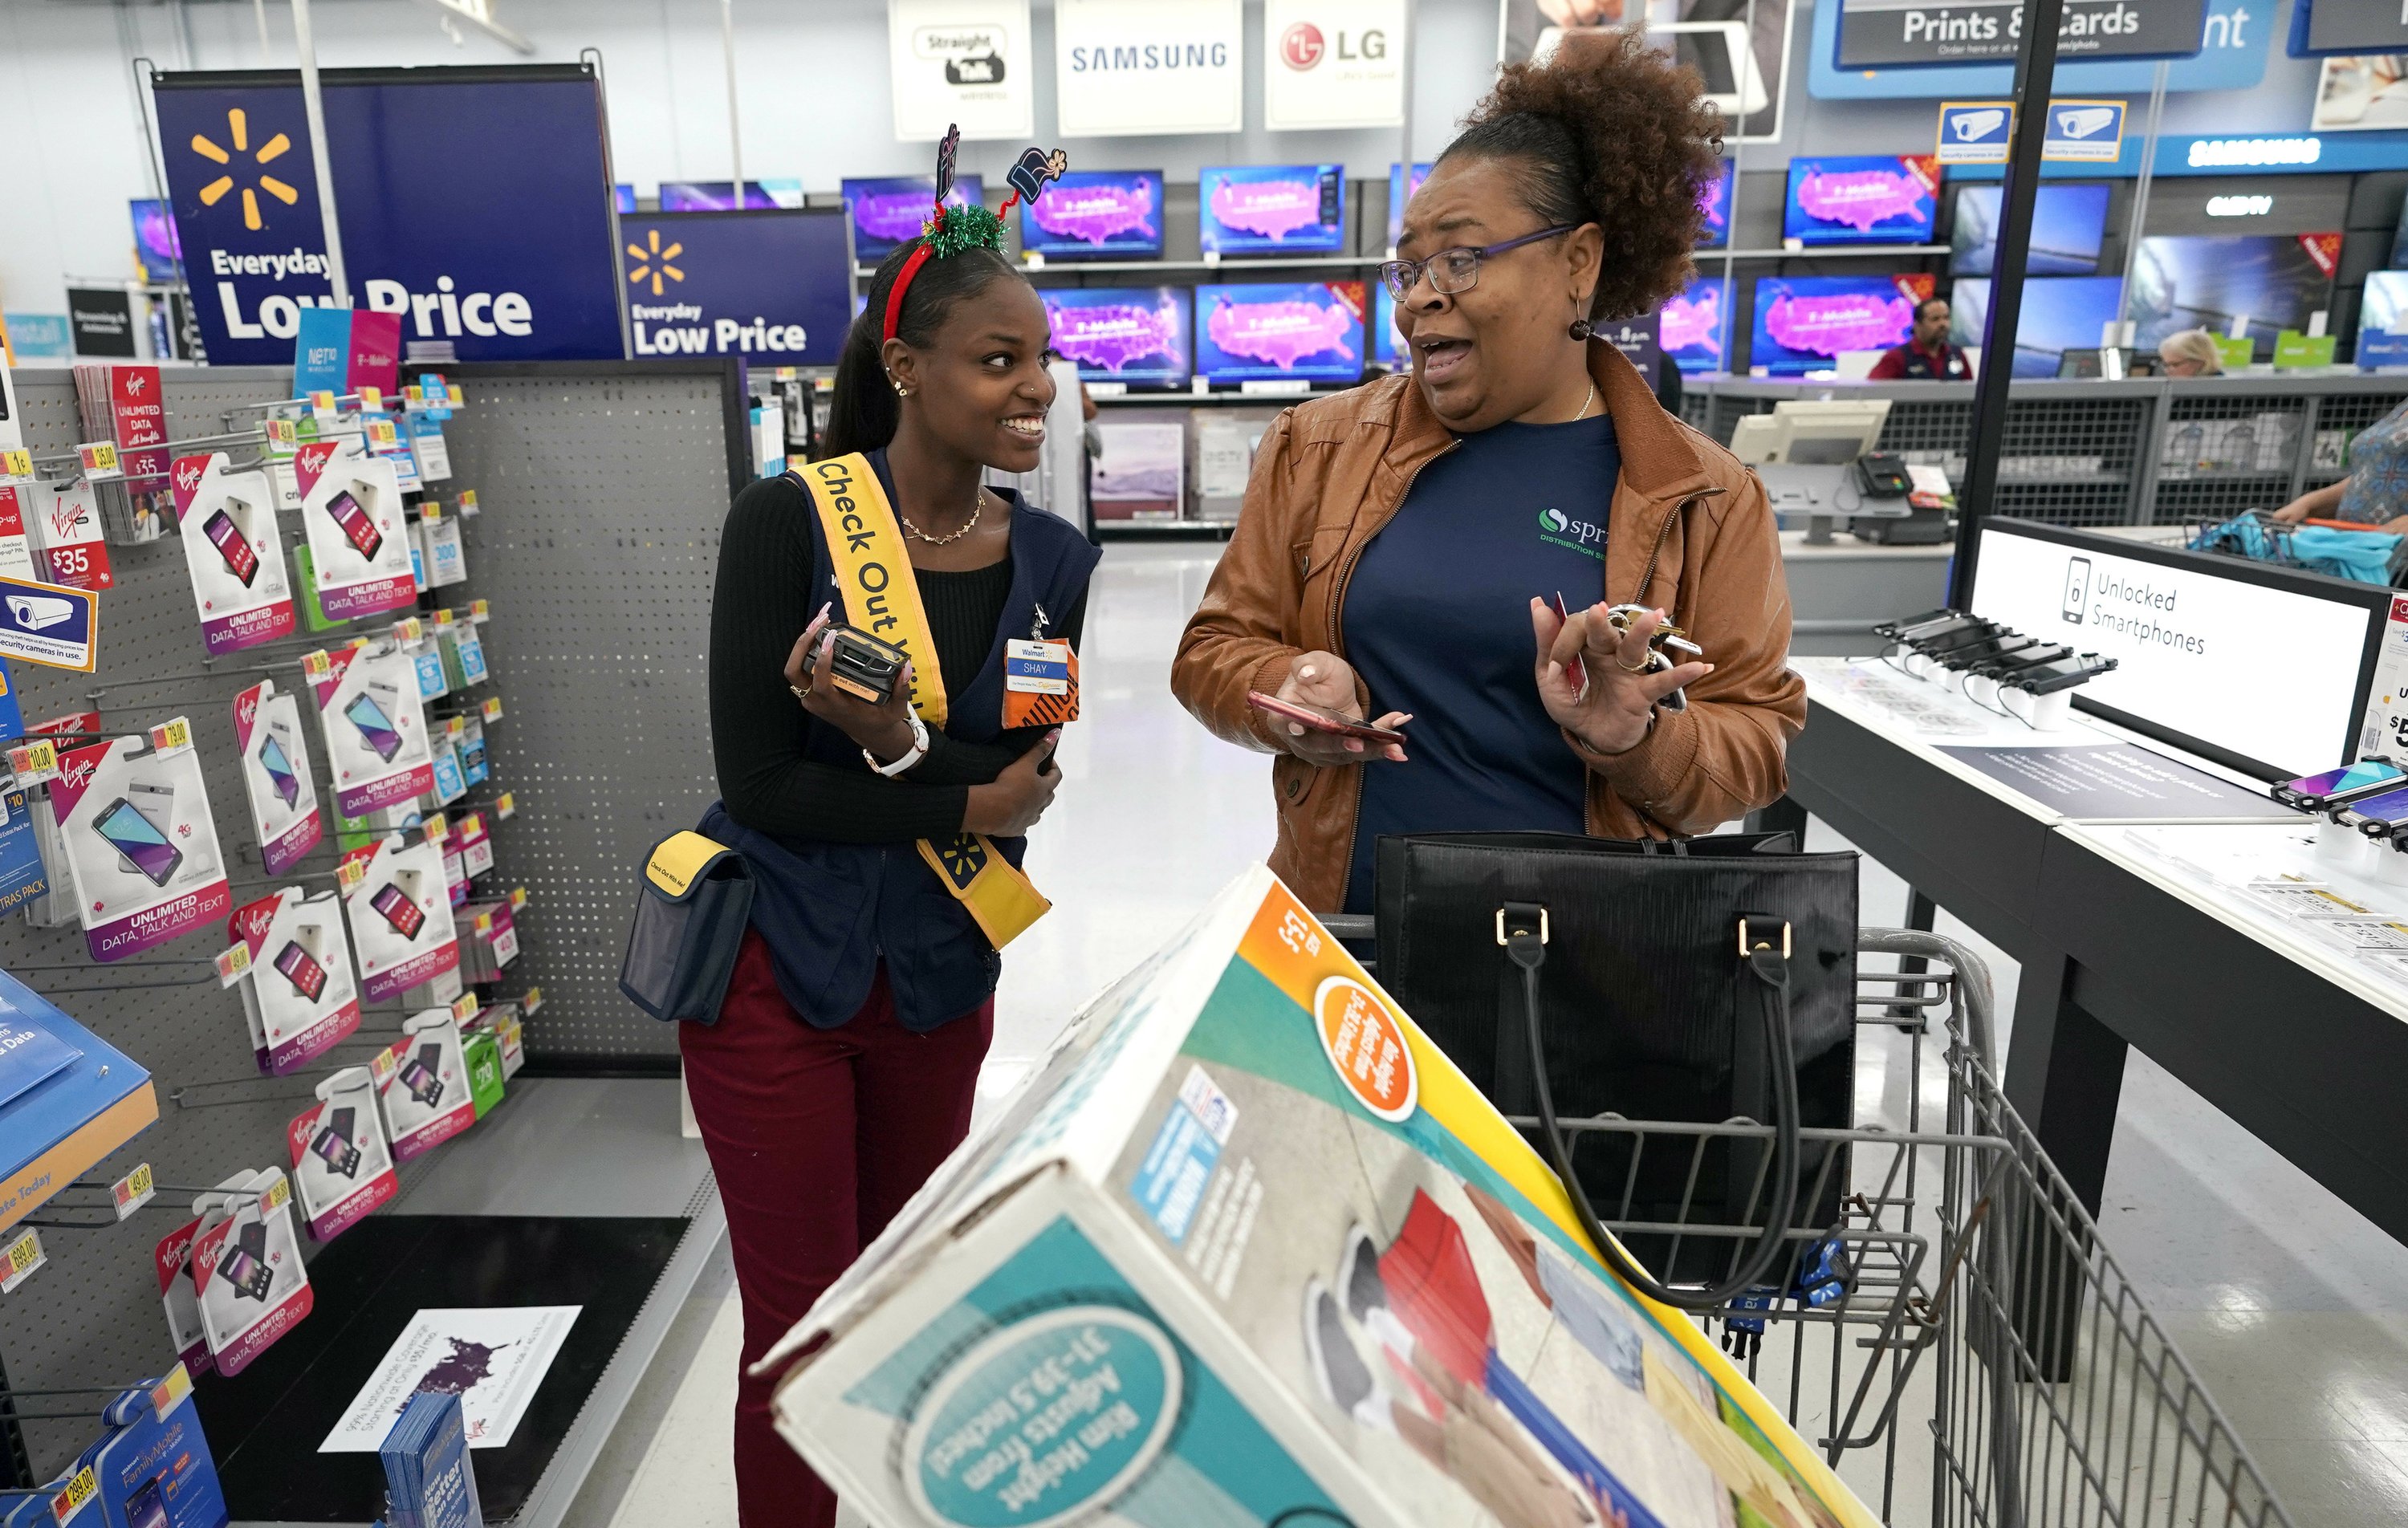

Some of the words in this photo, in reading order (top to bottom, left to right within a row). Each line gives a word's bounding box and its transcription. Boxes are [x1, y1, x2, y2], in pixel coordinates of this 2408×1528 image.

[1903, 10, 1999, 42] Prints
[928, 35, 992, 50] Straight
[1337, 30, 1386, 60] LG
[1072, 43, 1227, 73] SAMSUNG
[210, 250, 334, 281] Everyday
[365, 276, 533, 337] Price
[631, 303, 702, 322] Everyday
[633, 321, 710, 355] Low
[714, 316, 807, 352] Price
[119, 404, 160, 417] UNLIMITED
[131, 420, 152, 430] DATA
[177, 462, 200, 491] Virgin
[52, 497, 85, 538] Virgin
[817, 462, 877, 554] Check
[858, 562, 897, 633] Out
[1540, 534, 1594, 556] DISTRIBUTION
[53, 548, 89, 575] $35
[348, 580, 395, 597] UNLIMITED
[355, 595, 375, 605] TALK
[376, 591, 393, 601] AND
[394, 585, 413, 597] TEXT
[2097, 572, 2178, 613] Unlocked
[211, 631, 235, 644] DATA,
[236, 624, 254, 639] TALK
[254, 620, 271, 633] AND
[272, 612, 290, 627] TEXT
[230, 608, 272, 628] UNLIMITED
[2092, 605, 2206, 656] Smartphones
[0, 639, 25, 651] ecurity
[26, 644, 55, 656] cameras
[56, 649, 64, 657] in
[65, 652, 82, 660] use.
[1022, 648, 1045, 657] Walmart
[839, 676, 848, 685] out
[848, 681, 860, 690] with
[1023, 663, 1047, 673] SHAY
[59, 758, 93, 789] Virgin
[366, 772, 413, 794] UNLIMITED
[373, 790, 392, 801] TALK
[393, 781, 411, 793] AND
[412, 773, 430, 786] TEXT
[7, 793, 23, 807] $10
[178, 823, 191, 835] 4G
[283, 819, 310, 846] UNLIMITED
[299, 835, 310, 848] AND
[22, 879, 47, 898] PACK
[651, 861, 662, 873] Check
[661, 868, 669, 878] Out
[669, 873, 677, 884] With
[677, 880, 685, 888] Me!
[103, 933, 139, 951] DATA,
[140, 917, 169, 936] TALK
[172, 906, 196, 925] AND
[198, 894, 225, 912] TEXT
[131, 895, 197, 929] UNLIMITED
[249, 910, 272, 936] Virgin
[391, 952, 437, 977] UNLIMITED
[436, 951, 455, 965] TEXT
[2, 1030, 35, 1050] Data
[279, 1050, 303, 1067] DATA,
[303, 1038, 321, 1054] TALK
[322, 1026, 340, 1041] AND
[340, 1010, 356, 1027] TEXT
[296, 1014, 340, 1045] UNLIMITED
[337, 1185, 374, 1215] UNLIMITED
[375, 1183, 391, 1199] TEXT
[162, 1238, 189, 1268] Virgin
[199, 1238, 223, 1269] Virgin
[230, 1348, 251, 1367] DATA,
[251, 1333, 269, 1350] TALK
[269, 1318, 286, 1336] AND
[286, 1302, 304, 1321] TEXT
[244, 1307, 286, 1344] UNLIMITED
[1010, 1326, 1114, 1416] 31-39.5
[360, 1364, 399, 1411] Nationwide
[361, 1396, 396, 1432] Starting
[395, 1363, 418, 1384] Only
[1022, 1365, 1122, 1455] Adjusts
[925, 1398, 1011, 1479] Inches!
[1078, 1399, 1140, 1455] Rim
[964, 1438, 1031, 1492] from
[997, 1438, 1090, 1512] Height
[446, 1473, 462, 1501] ever
